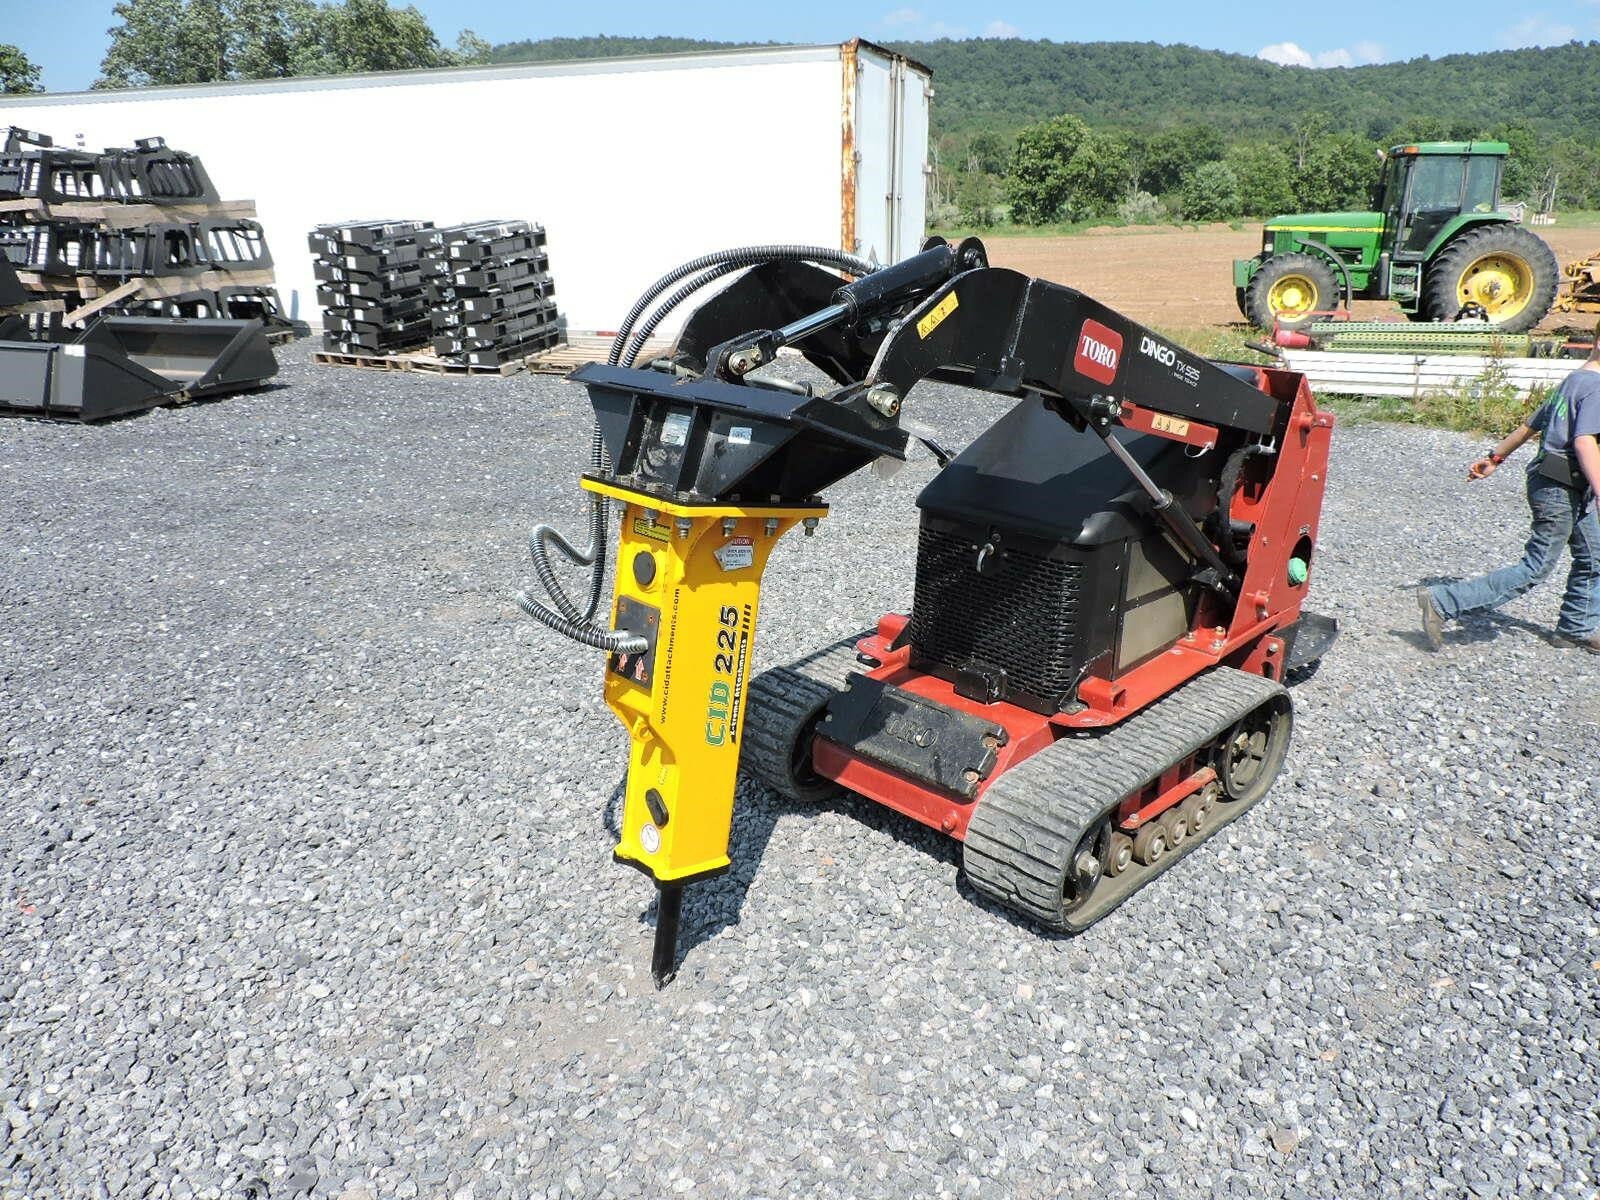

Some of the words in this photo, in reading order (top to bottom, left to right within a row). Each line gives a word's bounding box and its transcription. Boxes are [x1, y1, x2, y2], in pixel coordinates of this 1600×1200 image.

[1081, 335, 1117, 369] TORO
[1140, 336, 1175, 366] DINGO
[660, 588, 680, 724] www.cidattachments.com
[714, 605, 739, 675] 225
[735, 638, 747, 697] Attachments
[705, 681, 730, 746] CID
